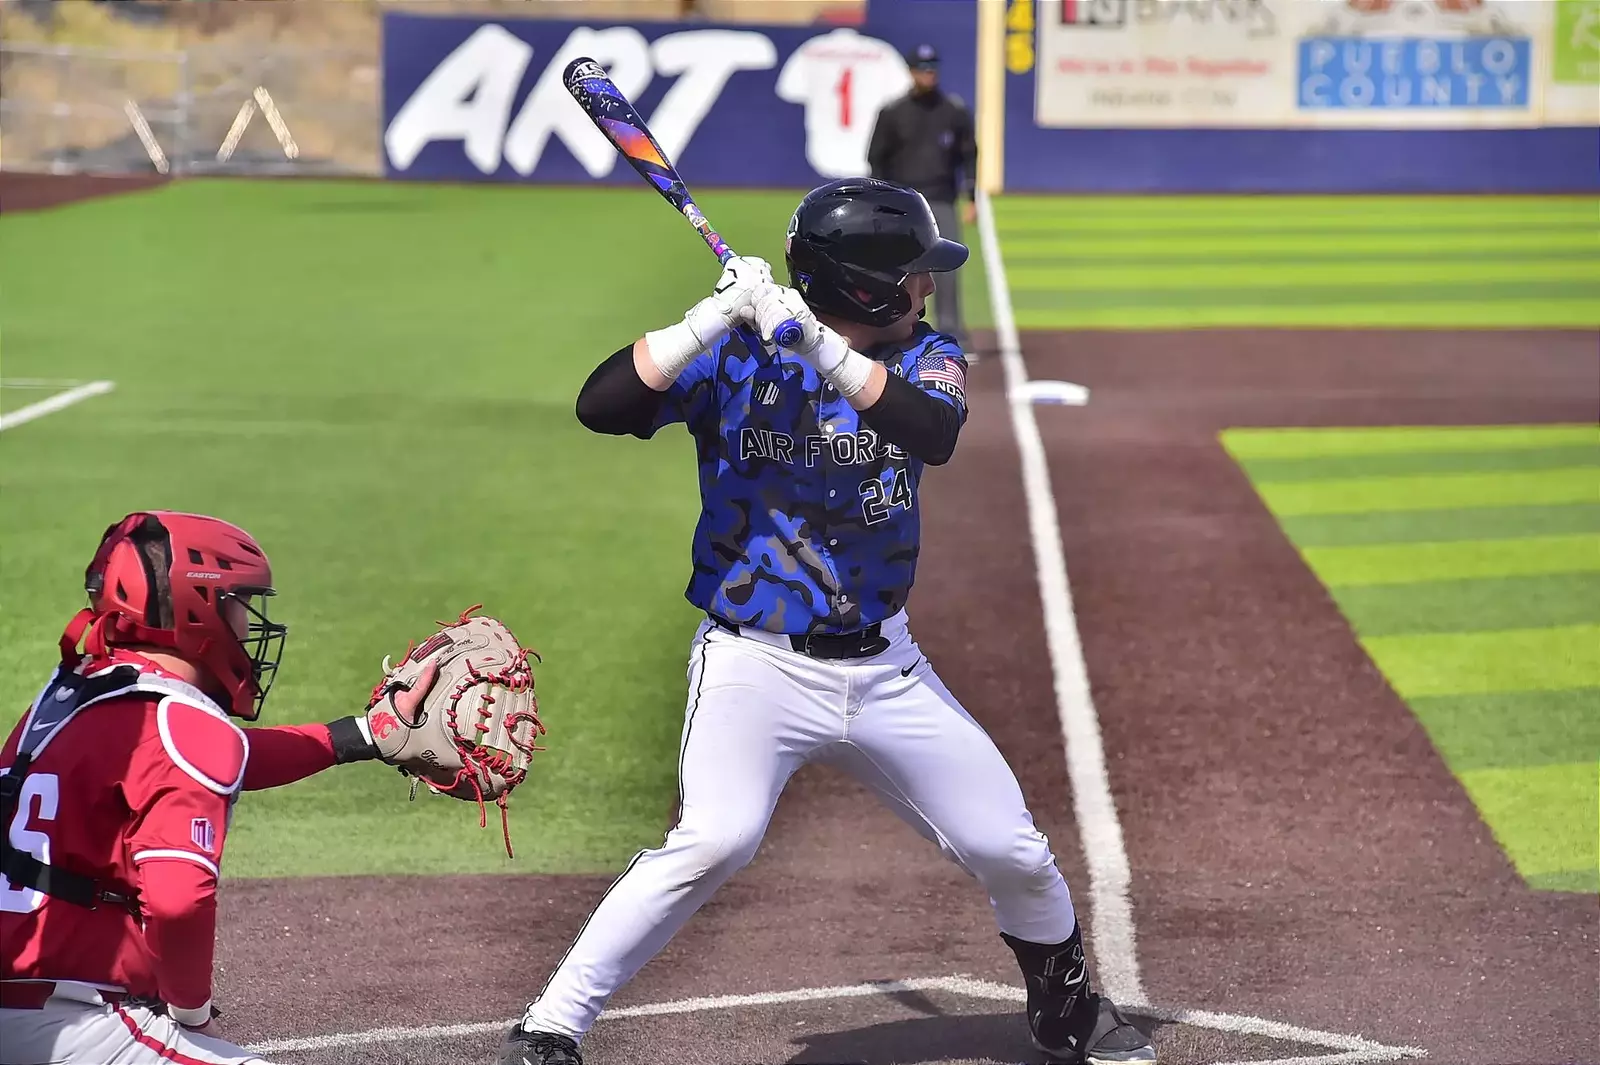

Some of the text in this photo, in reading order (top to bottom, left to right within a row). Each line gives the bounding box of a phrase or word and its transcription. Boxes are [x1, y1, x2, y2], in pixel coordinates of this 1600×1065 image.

[1309, 39, 1517, 75] PUEBLO
[385, 24, 776, 178] ART
[834, 68, 854, 128] 1
[1301, 72, 1520, 107] COUNTY
[740, 427, 795, 465] AIR
[858, 468, 913, 526] 24
[0, 767, 59, 914] 6
